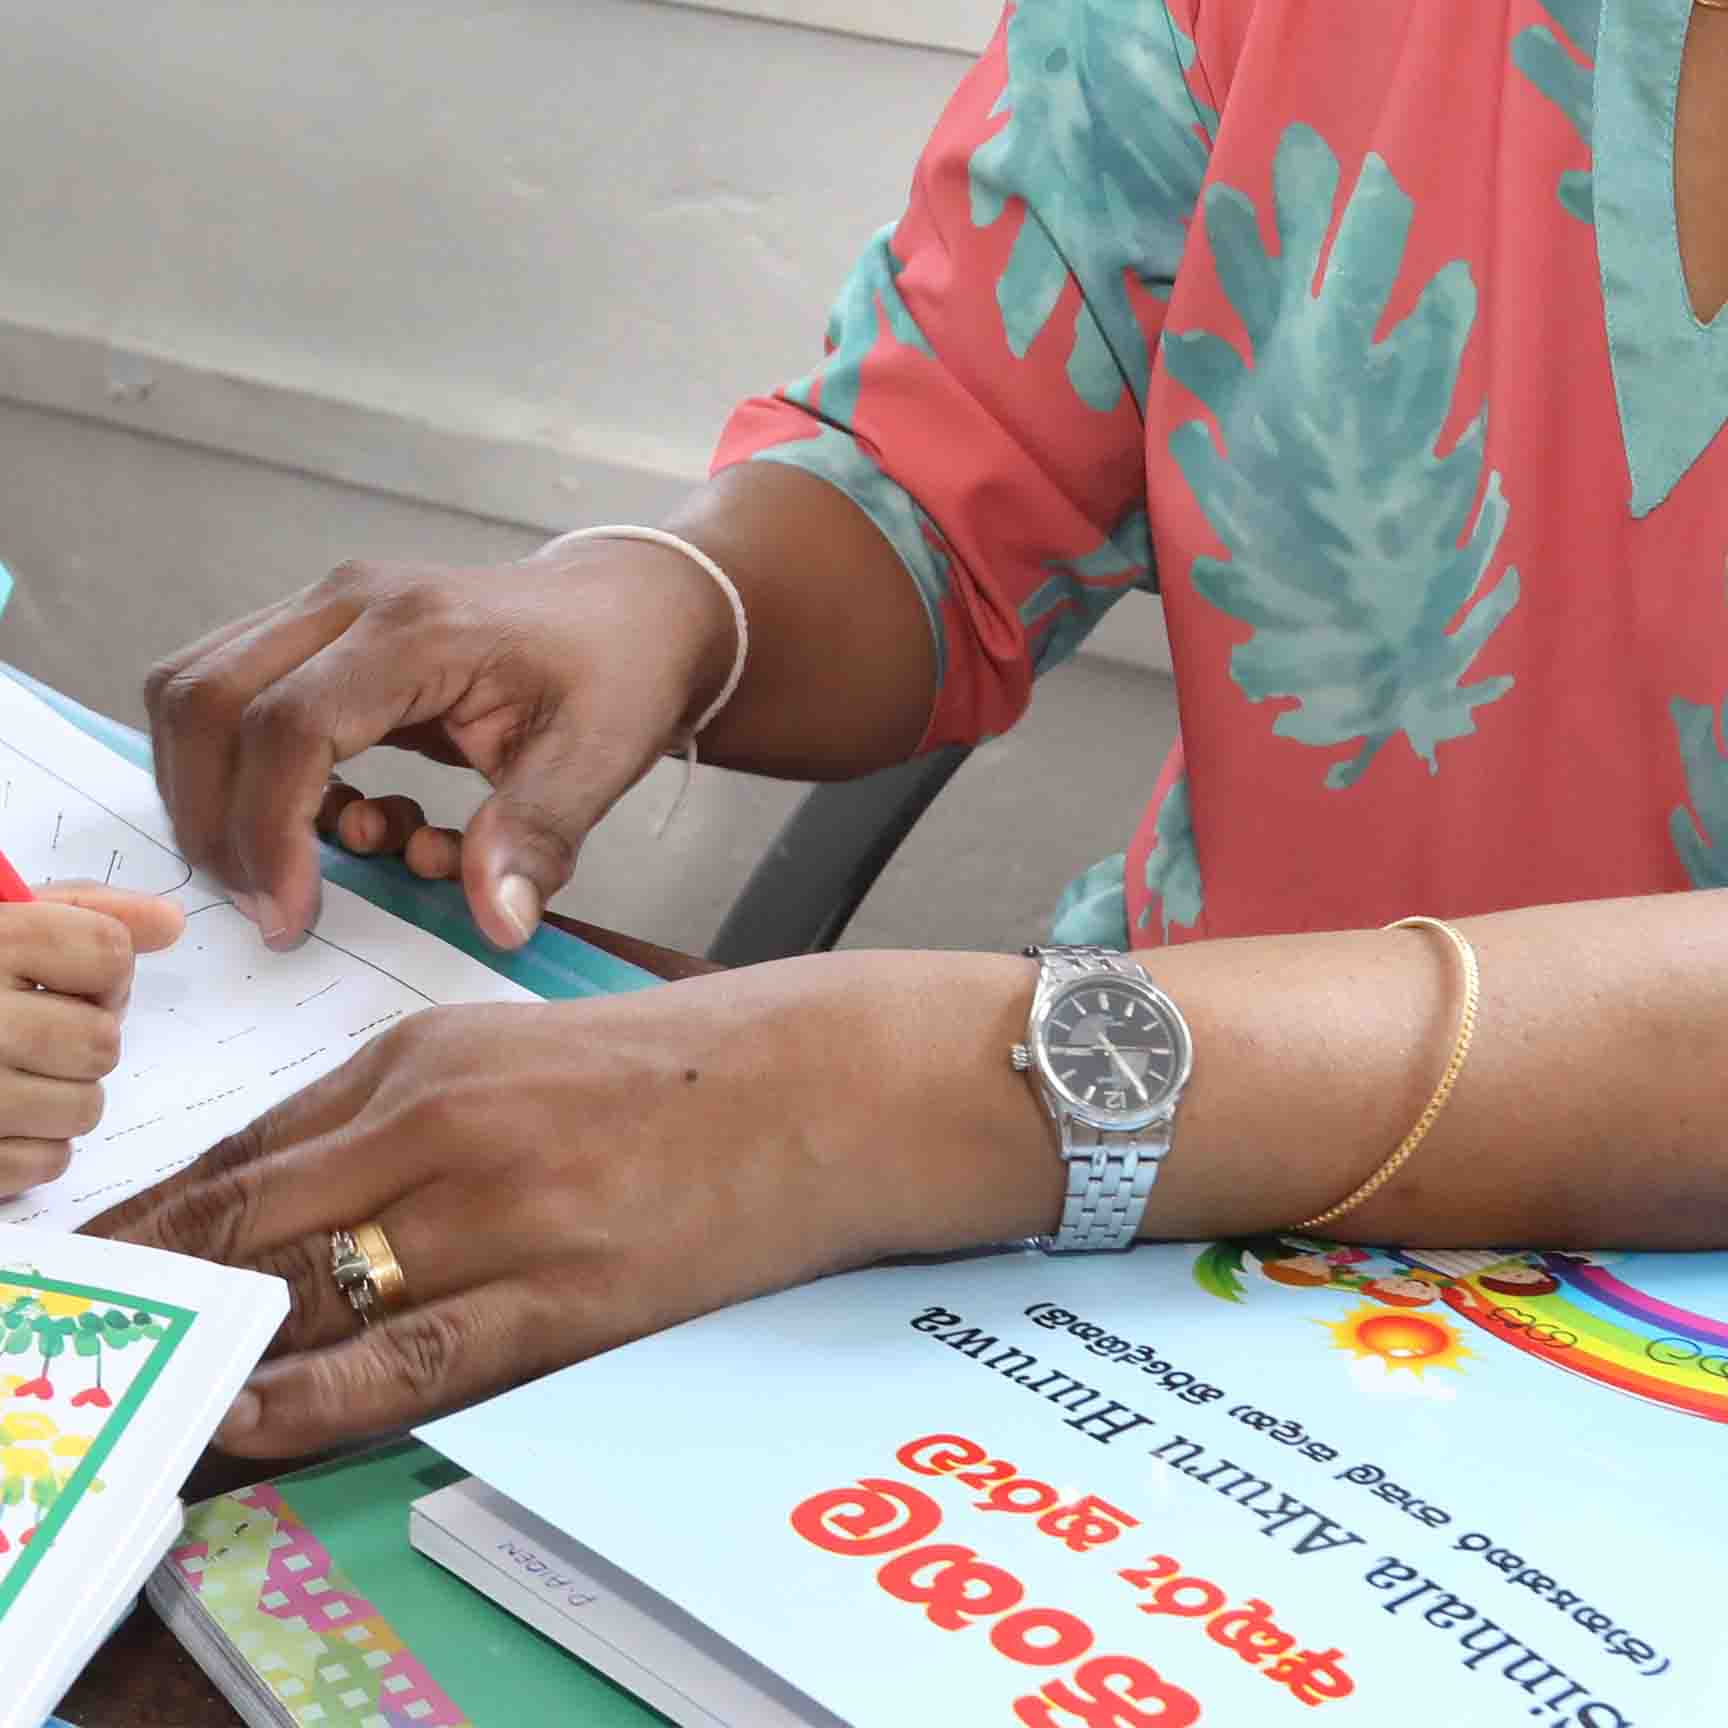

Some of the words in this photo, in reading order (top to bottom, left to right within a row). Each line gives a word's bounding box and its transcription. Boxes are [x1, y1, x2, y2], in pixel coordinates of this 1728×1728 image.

[910, 1307, 1155, 1445] Huruwa
[1228, 1405, 1339, 1463] සඳහා
[896, 1435, 1140, 1553] හුරුව
[1151, 1435, 1367, 1556] Akuru
[1334, 1463, 1451, 1528] පාසල්
[790, 1478, 1201, 1728] සිංහල
[1118, 1555, 1355, 1706] අකුරු
